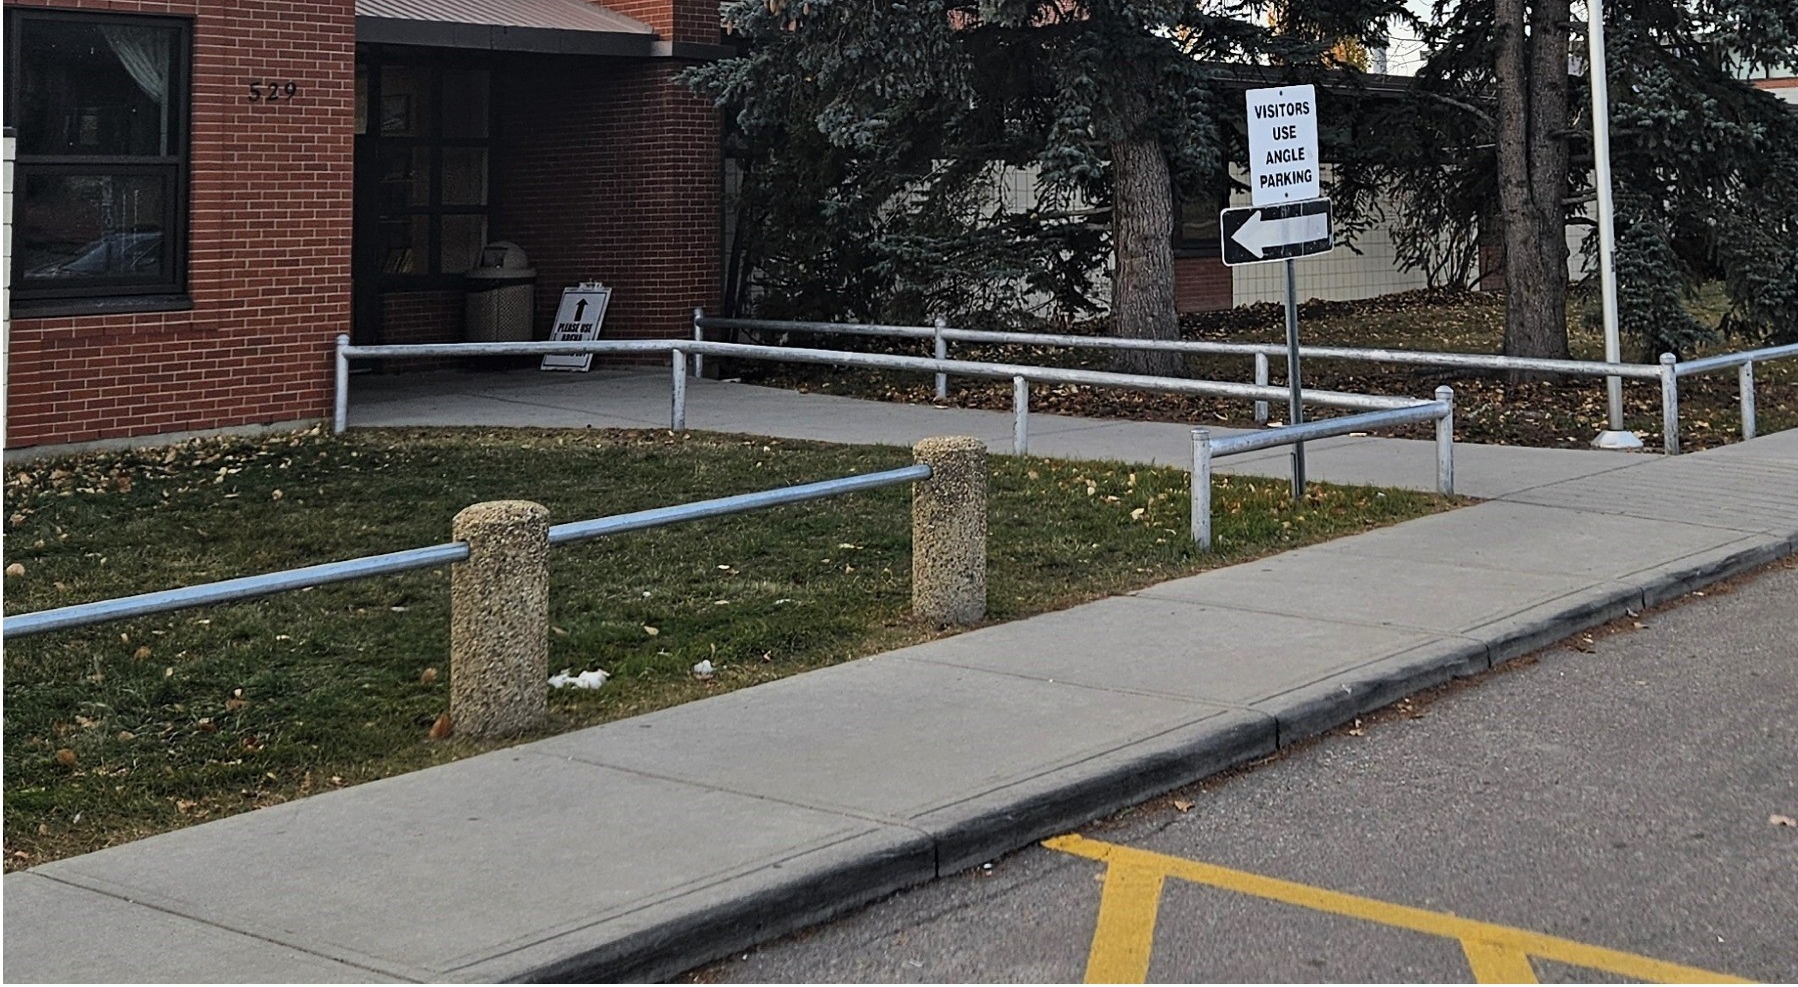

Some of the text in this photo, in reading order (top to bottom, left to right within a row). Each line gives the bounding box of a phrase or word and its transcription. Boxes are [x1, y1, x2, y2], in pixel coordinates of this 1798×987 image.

[249, 82, 297, 102] 529
[1254, 101, 1310, 119] VISITORS
[1272, 125, 1297, 140] USE
[1265, 147, 1305, 165] ANGLE
[1260, 169, 1312, 189] PARKING
[558, 323, 593, 333] PLEASE USE
